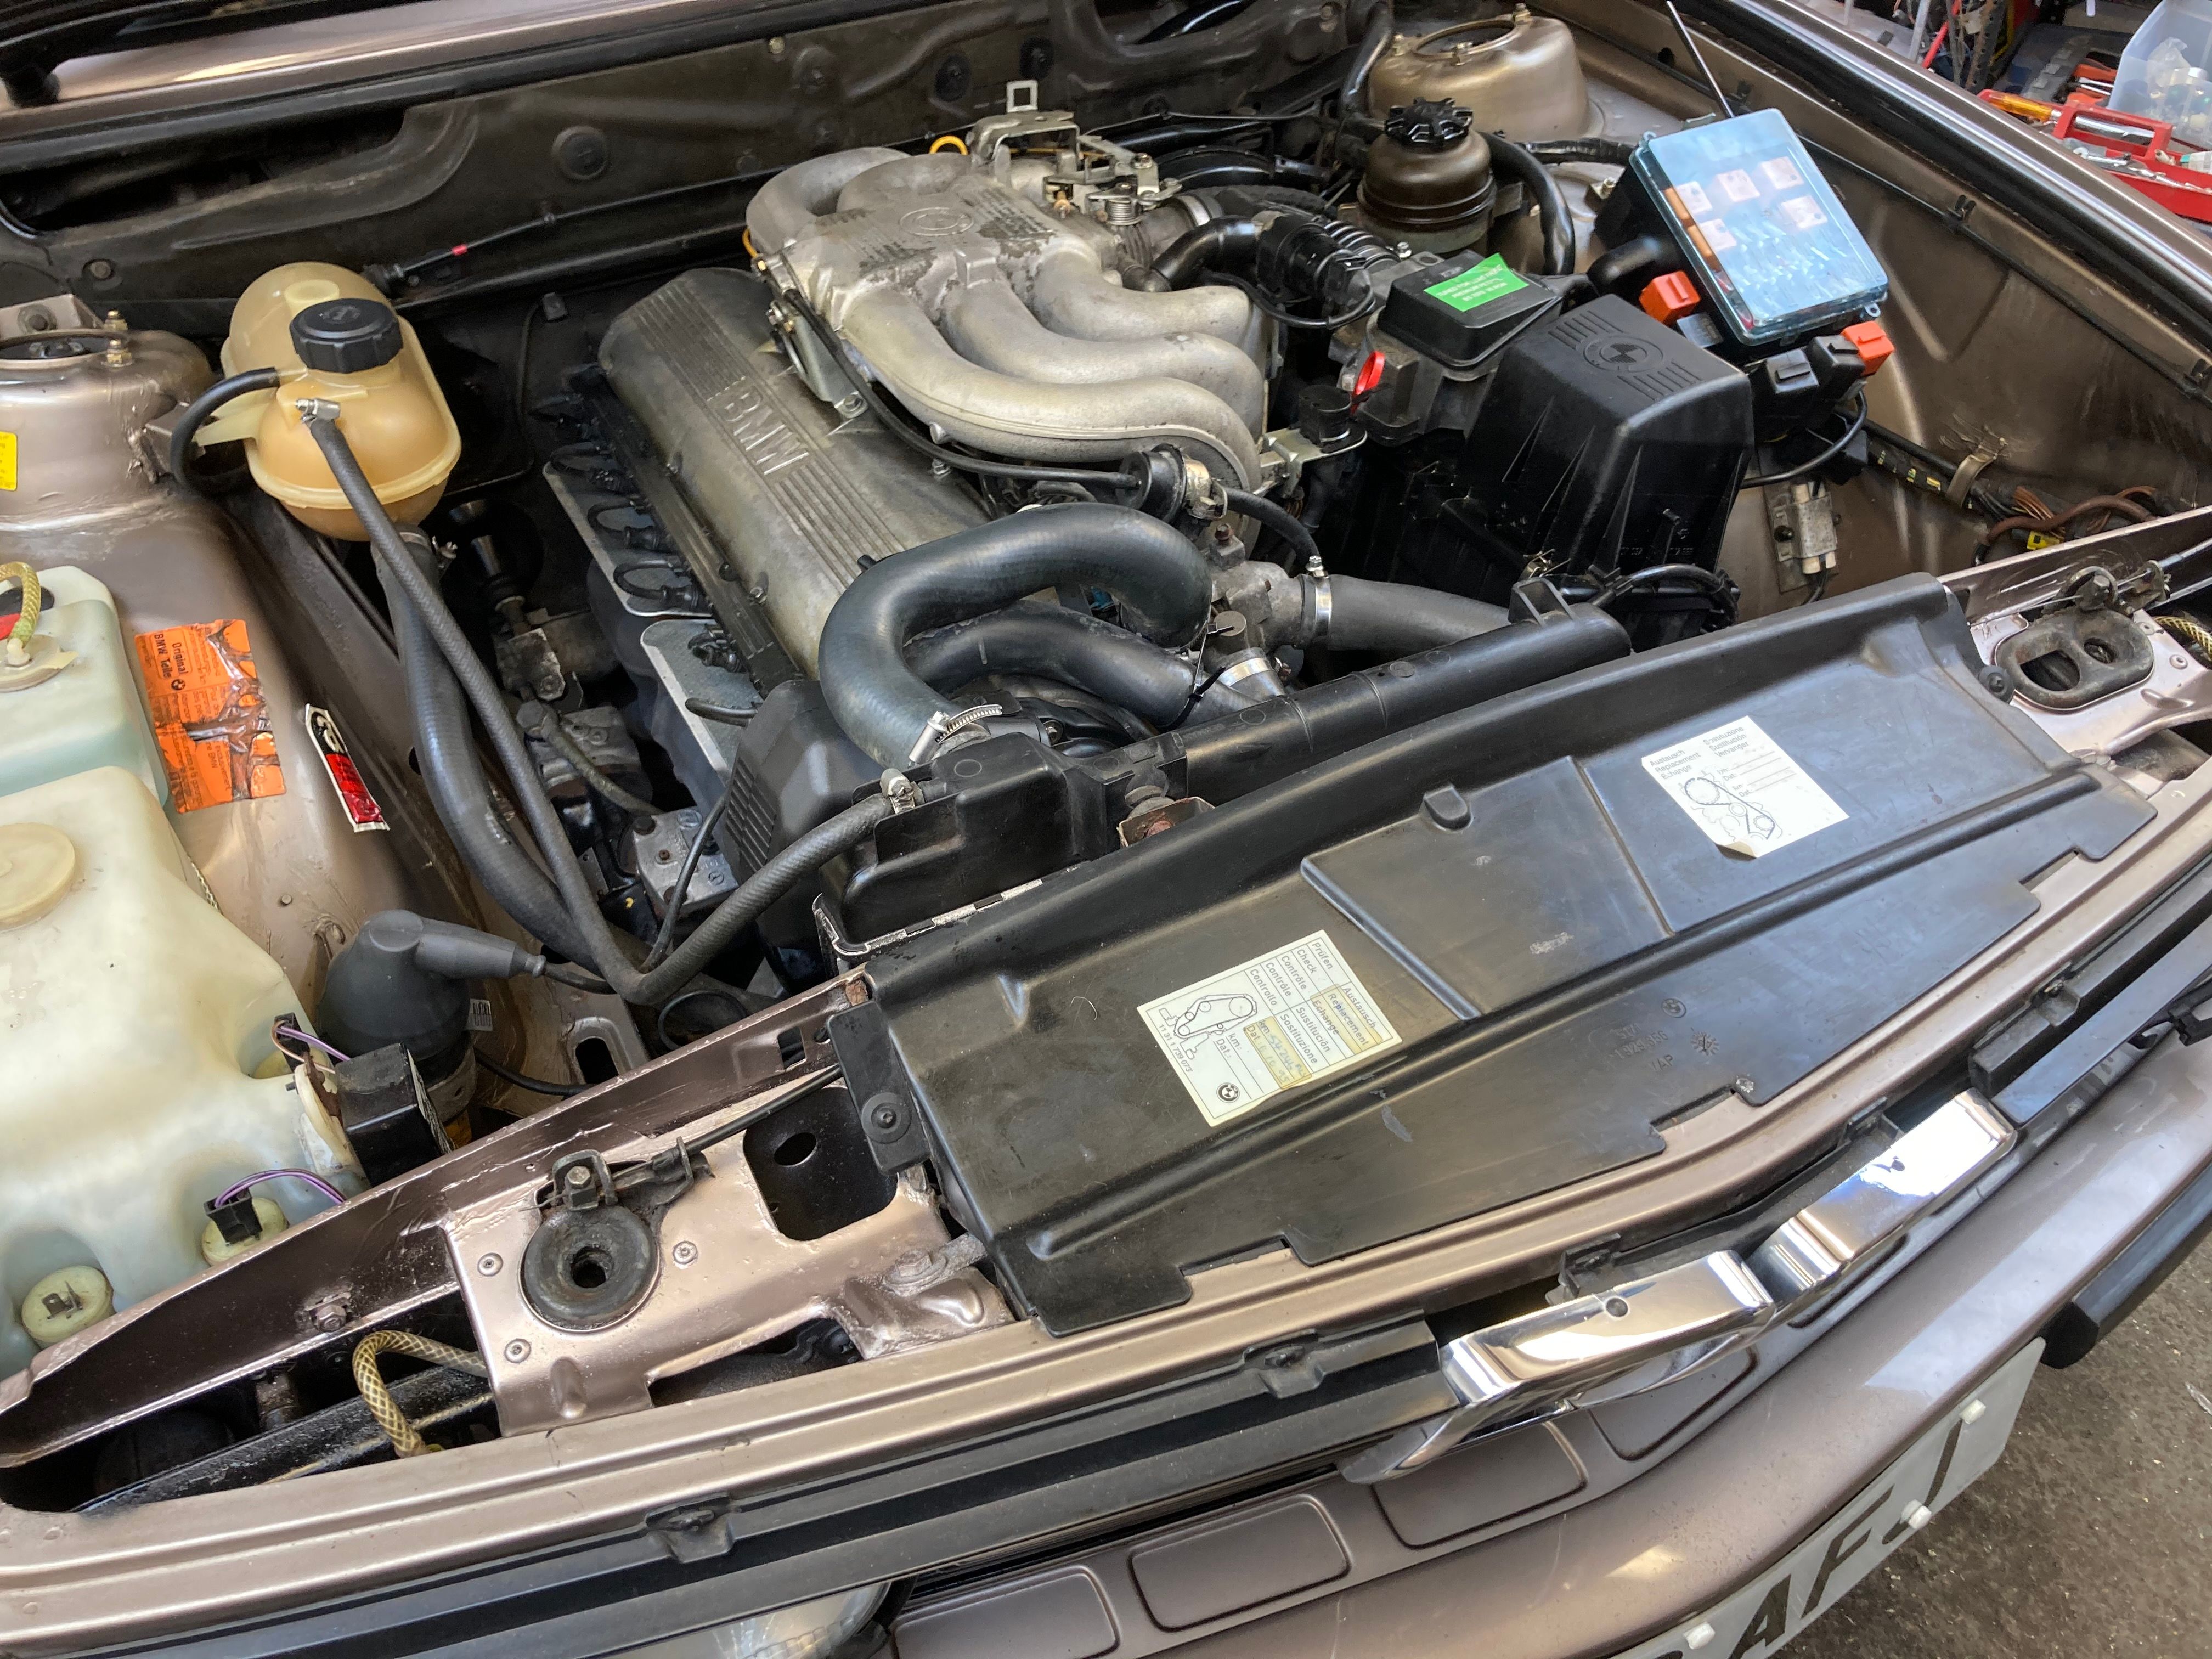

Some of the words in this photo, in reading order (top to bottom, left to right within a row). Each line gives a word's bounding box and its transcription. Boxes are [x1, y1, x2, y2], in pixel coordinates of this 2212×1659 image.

[720, 385, 810, 476] BMW
[154, 634, 168, 654] BMW
[161, 658, 172, 678] Teile
[172, 643, 188, 675] Original
[208, 753, 217, 768] BMW
[1650, 751, 1685, 766] Austausch
[1656, 753, 1701, 772] Replacement
[1709, 734, 1746, 752] Sustitución
[1715, 742, 1748, 757] Vervanger
[1266, 962, 1291, 996] Contrôle
[1282, 956, 1307, 989] Contrôle
[1312, 1001, 1339, 1035] Echange
[1297, 949, 1317, 973] Check
[1329, 994, 1368, 1045] Replacement
[1312, 943, 1333, 969] Prüfen
[1343, 989, 1375, 1028] Austausch
[1250, 969, 1277, 1005] Controllo
[1280, 1014, 1317, 1063] Sostituzione
[1228, 1032, 1242, 1050] km:
[1173, 1047, 1184, 1059] 739
[1181, 1060, 1192, 1072] 073
